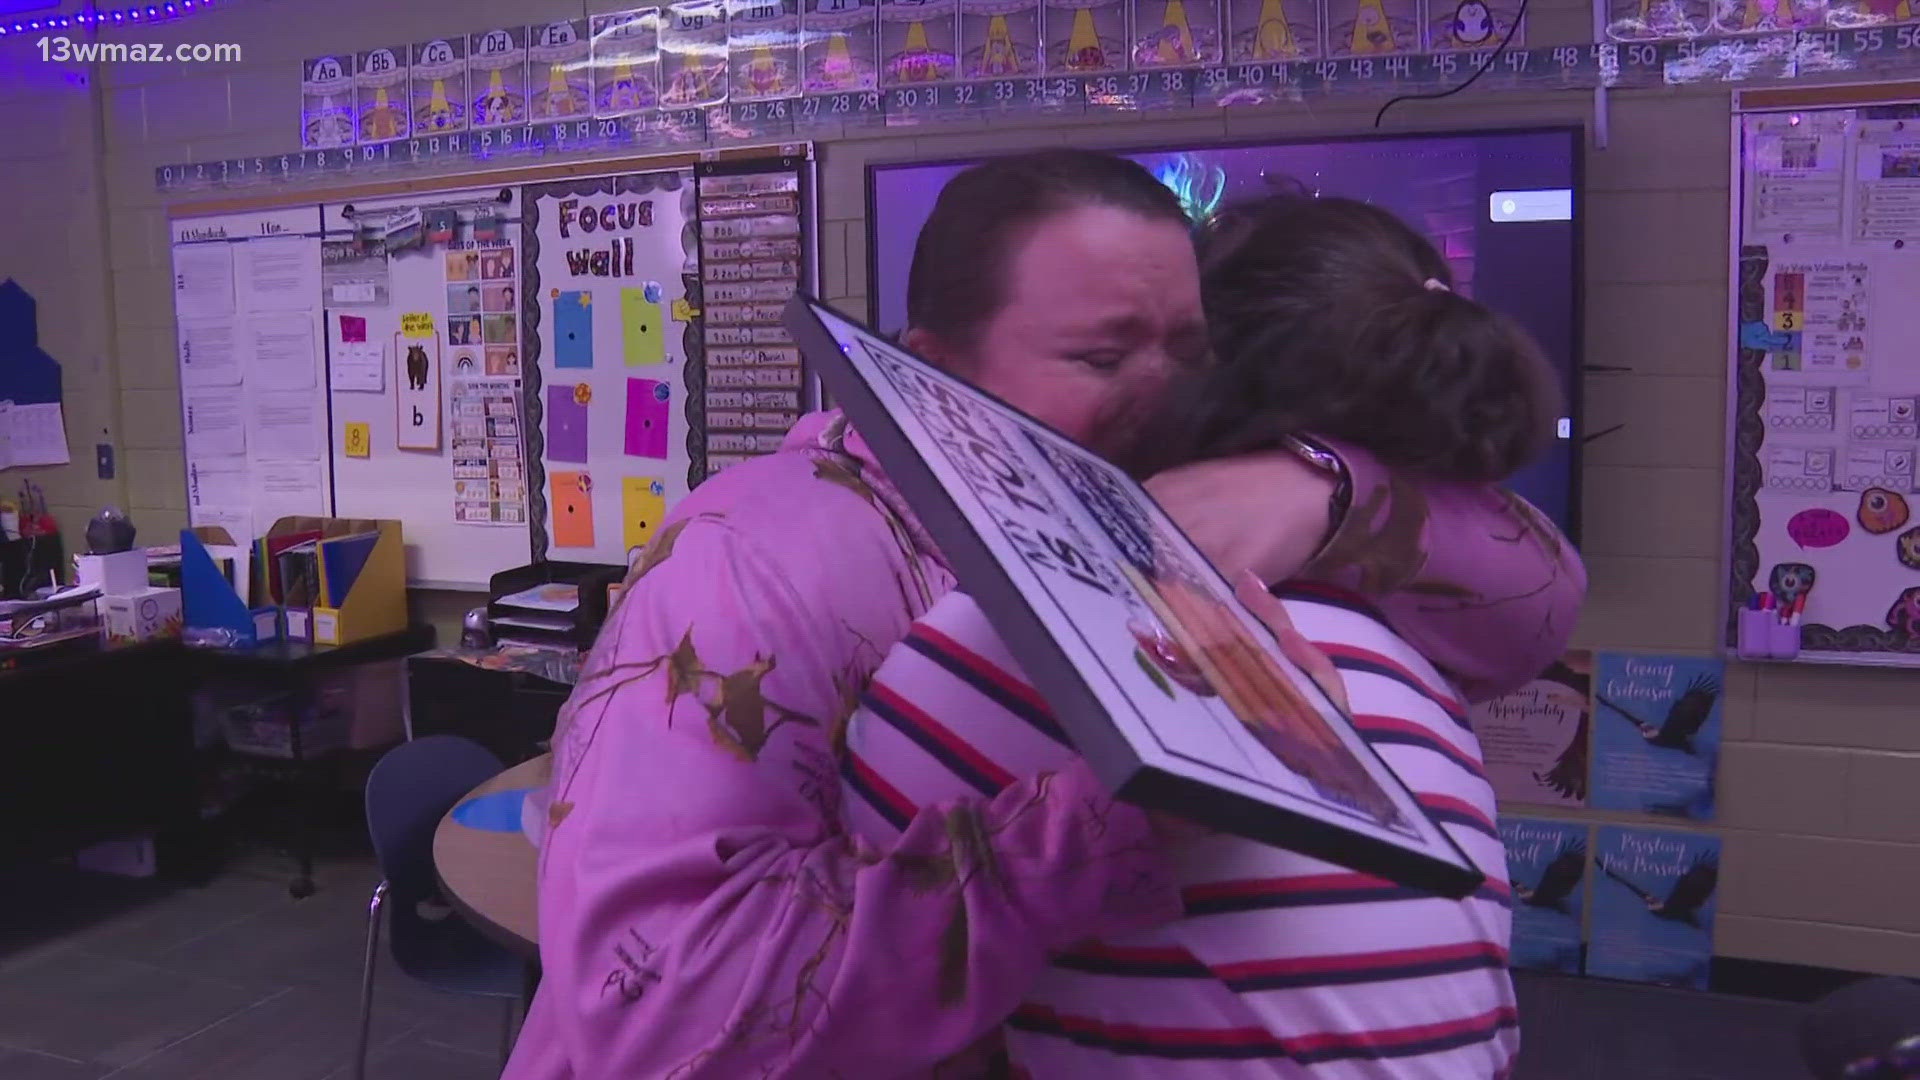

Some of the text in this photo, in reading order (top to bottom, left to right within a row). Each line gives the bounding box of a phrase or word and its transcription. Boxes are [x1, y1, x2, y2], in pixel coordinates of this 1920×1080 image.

[486, 34, 507, 52] Dd
[549, 26, 569, 45] Ee
[371, 54, 391, 72] Bb
[428, 45, 447, 63] Cc
[317, 63, 337, 80] Aa
[164, 167, 172, 182] 0
[221, 160, 228, 174] 3
[237, 159, 246, 174] 4
[256, 158, 264, 172] 5
[281, 156, 289, 170] 6
[299, 154, 306, 169] 7
[317, 151, 326, 166] 8
[344, 149, 353, 163] 9
[362, 146, 375, 161] 10
[383, 144, 390, 159] 11
[409, 140, 421, 155] 12
[429, 138, 440, 154] 13
[449, 136, 461, 151] 14
[480, 131, 493, 146] 15
[500, 129, 512, 144] 16
[522, 127, 534, 143] 17
[555, 124, 567, 140] 18
[576, 122, 590, 138] 19
[598, 121, 617, 137] 20
[634, 116, 647, 132] 21
[656, 113, 673, 128] 22
[680, 111, 697, 127] 23
[740, 104, 758, 121] 25
[766, 102, 786, 119] 26
[802, 98, 820, 116] 27
[831, 95, 850, 112] 28
[858, 93, 880, 111] 29
[896, 89, 918, 107] 30
[925, 87, 940, 105] 31
[954, 85, 974, 104] 32
[994, 82, 1014, 99] 33
[1026, 80, 1047, 98] 34
[1055, 78, 1077, 97] 35
[1096, 77, 1118, 94] 36
[1128, 74, 1150, 93] 37
[1161, 72, 1183, 91] 38
[1204, 68, 1229, 88] 39
[1238, 66, 1264, 85] 40
[1271, 64, 1288, 84] 41
[1315, 61, 1338, 82] 42
[1350, 60, 1374, 79] 43
[1385, 56, 1411, 78] 44
[1432, 54, 1457, 74] 45
[1469, 51, 1496, 73] 46
[1505, 50, 1530, 73] 47
[1552, 47, 1578, 68] 48
[1627, 45, 1657, 66] 50
[1854, 29, 1884, 51] 55
[566, 237, 635, 278] wall
[1782, 312, 1794, 330] 3
[1781, 354, 1793, 371] 1
[412, 405, 424, 426] b
[352, 428, 361, 447] 8
[913, 373, 1050, 516] TOPS
[1035, 528, 1114, 596] IS
